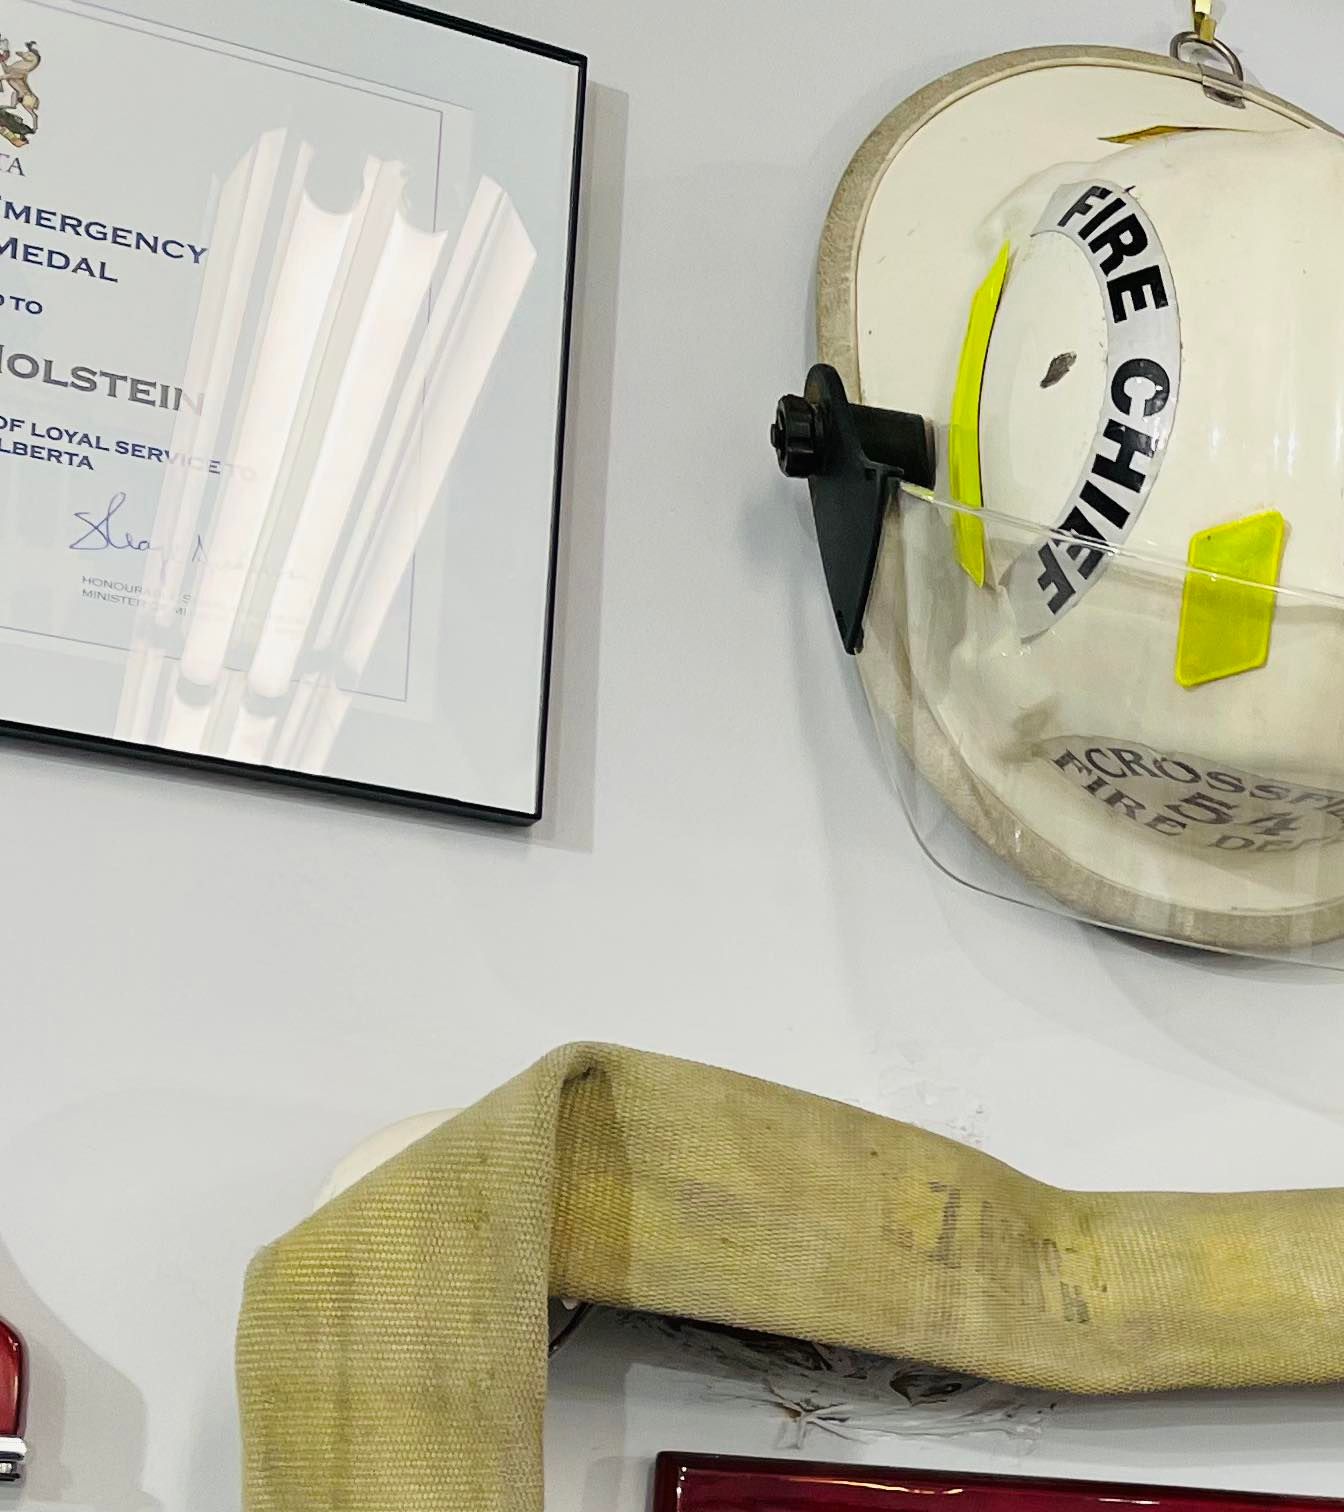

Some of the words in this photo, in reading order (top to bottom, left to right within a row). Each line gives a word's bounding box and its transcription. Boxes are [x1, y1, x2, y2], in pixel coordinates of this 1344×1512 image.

[0, 197, 208, 264] MERGENCY
[1057, 185, 1169, 323] FIRE
[0, 344, 205, 416] OLSTEIN
[30, 422, 110, 452] LOYAL
[114, 440, 220, 475] SERVICE
[1037, 358, 1170, 615] CHIEF
